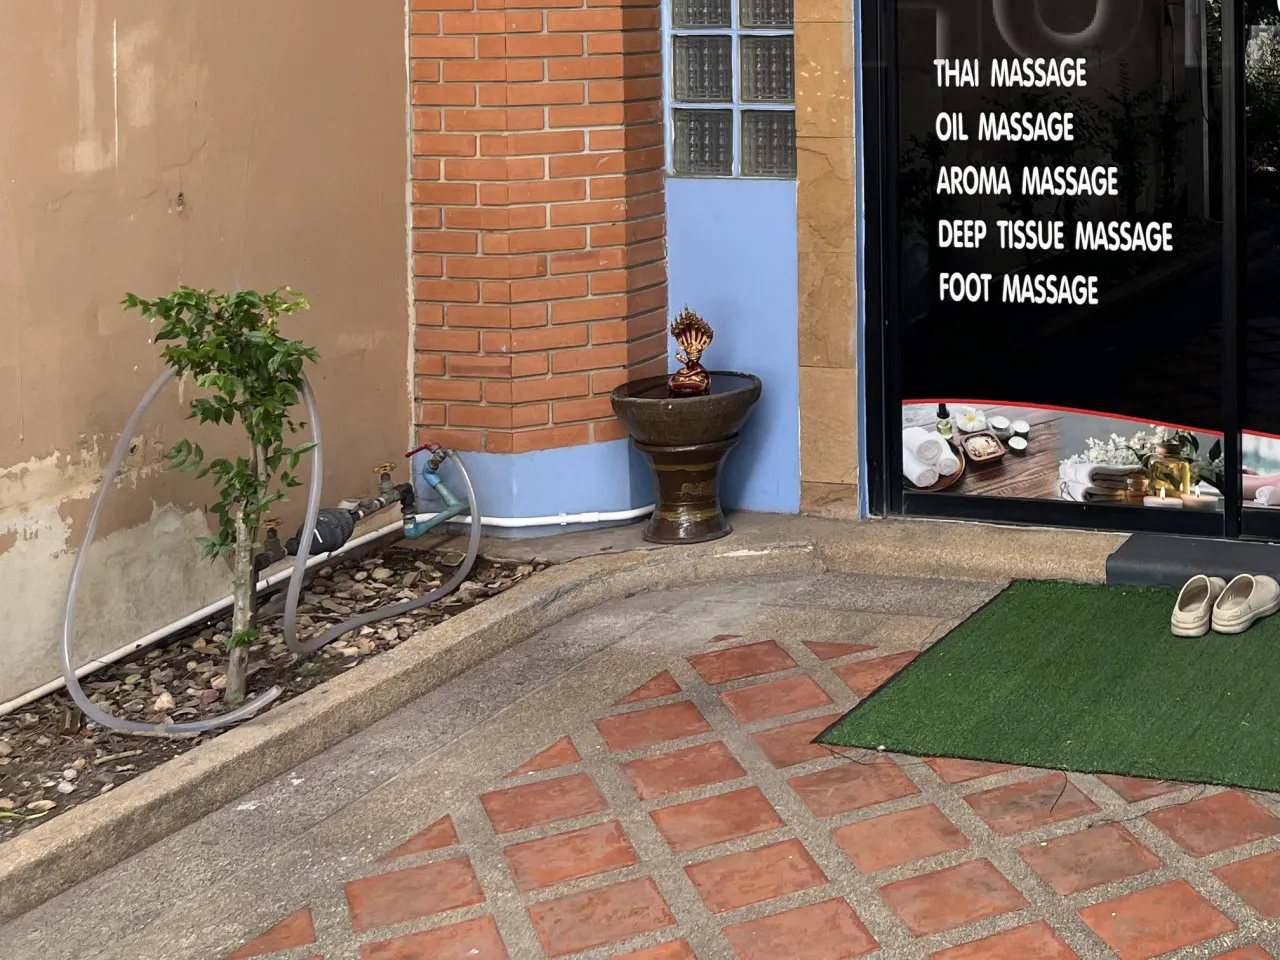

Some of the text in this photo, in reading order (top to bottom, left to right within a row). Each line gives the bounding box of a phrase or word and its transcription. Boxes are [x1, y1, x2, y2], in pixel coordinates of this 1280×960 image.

[934, 57, 1087, 88] THAI MASSAGE
[936, 112, 1074, 141] OIL MASSAGE
[936, 166, 1119, 196] AROMA MASSAGE
[938, 219, 1173, 252] DEEP TISSUE MASSAGE
[939, 272, 1099, 305] FOOT MASSAGE
